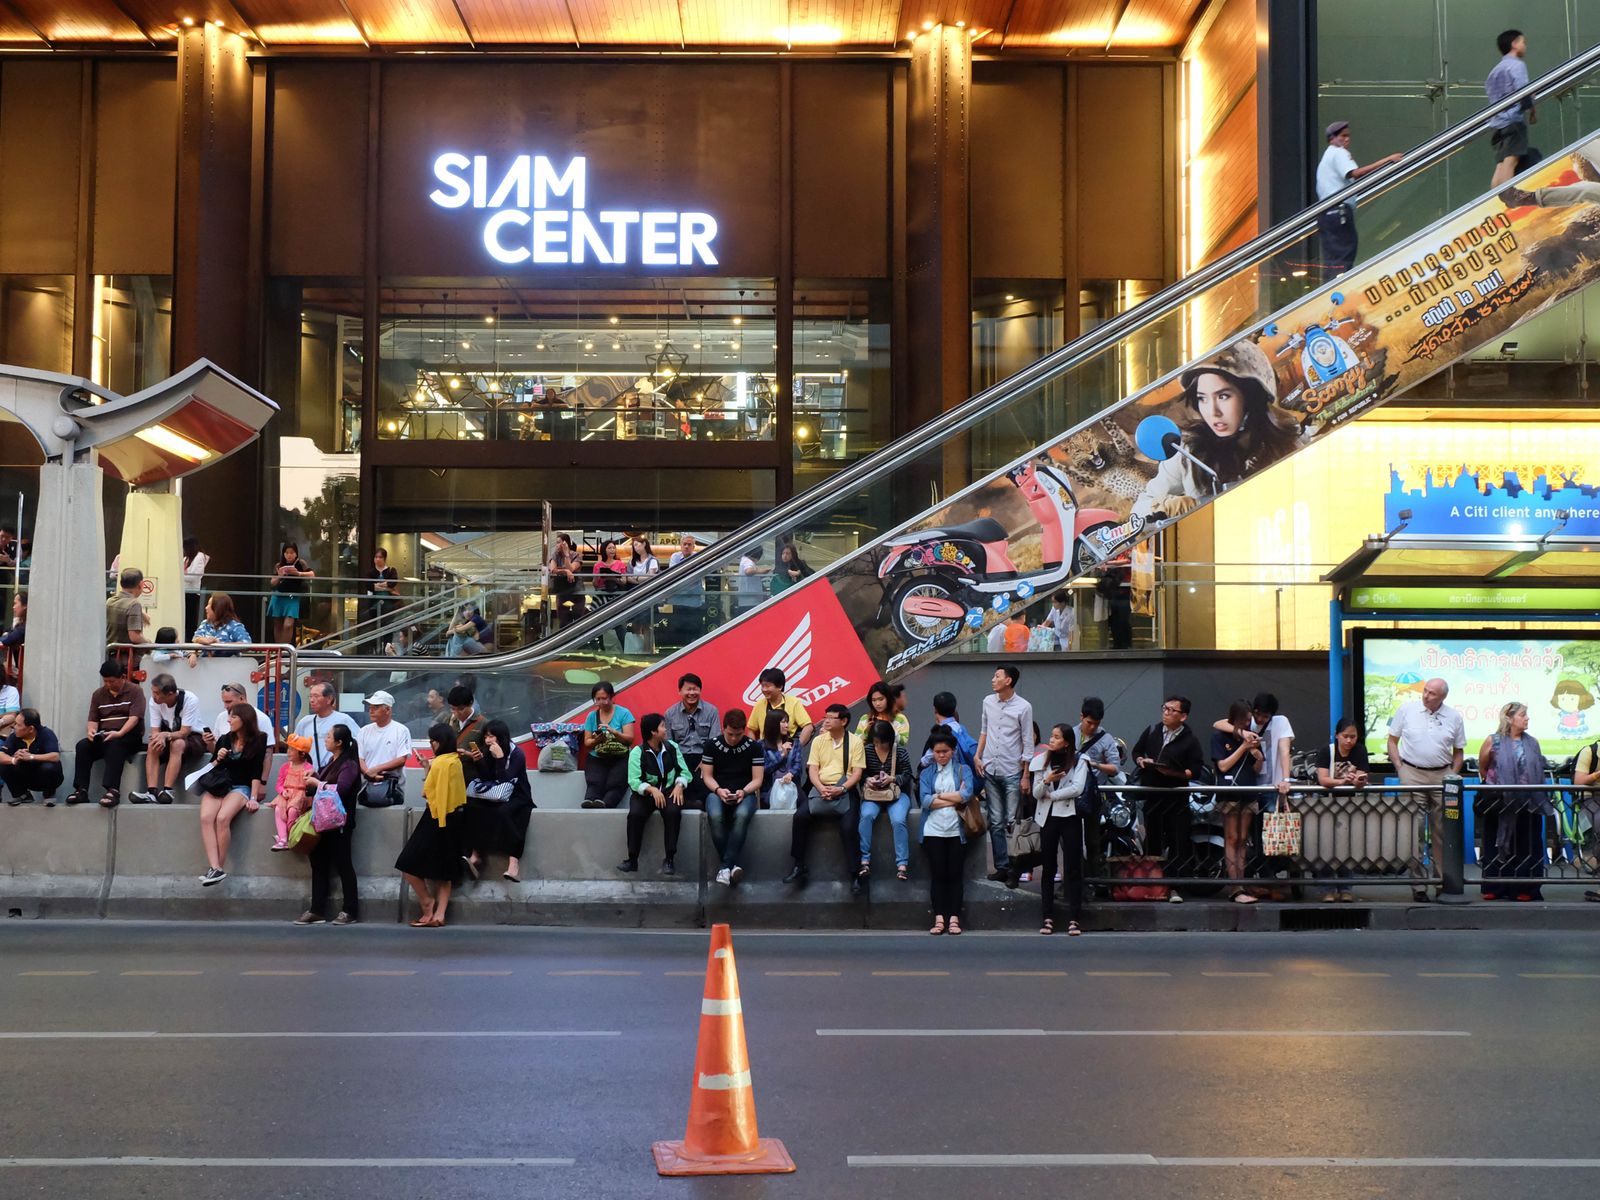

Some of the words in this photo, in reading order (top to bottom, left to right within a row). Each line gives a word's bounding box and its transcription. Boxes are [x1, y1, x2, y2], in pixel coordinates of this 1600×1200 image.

[430, 153, 585, 208] SIAM
[484, 209, 719, 265] CENTER
[1450, 506, 1460, 517] A
[1464, 505, 1488, 517] Citi
[1492, 505, 1530, 518] client
[886, 658, 909, 675] FUEL
[911, 631, 958, 660] INJECTION
[801, 676, 851, 707] NDA
[715, 740, 730, 753] NEW
[732, 741, 751, 754] YORK
